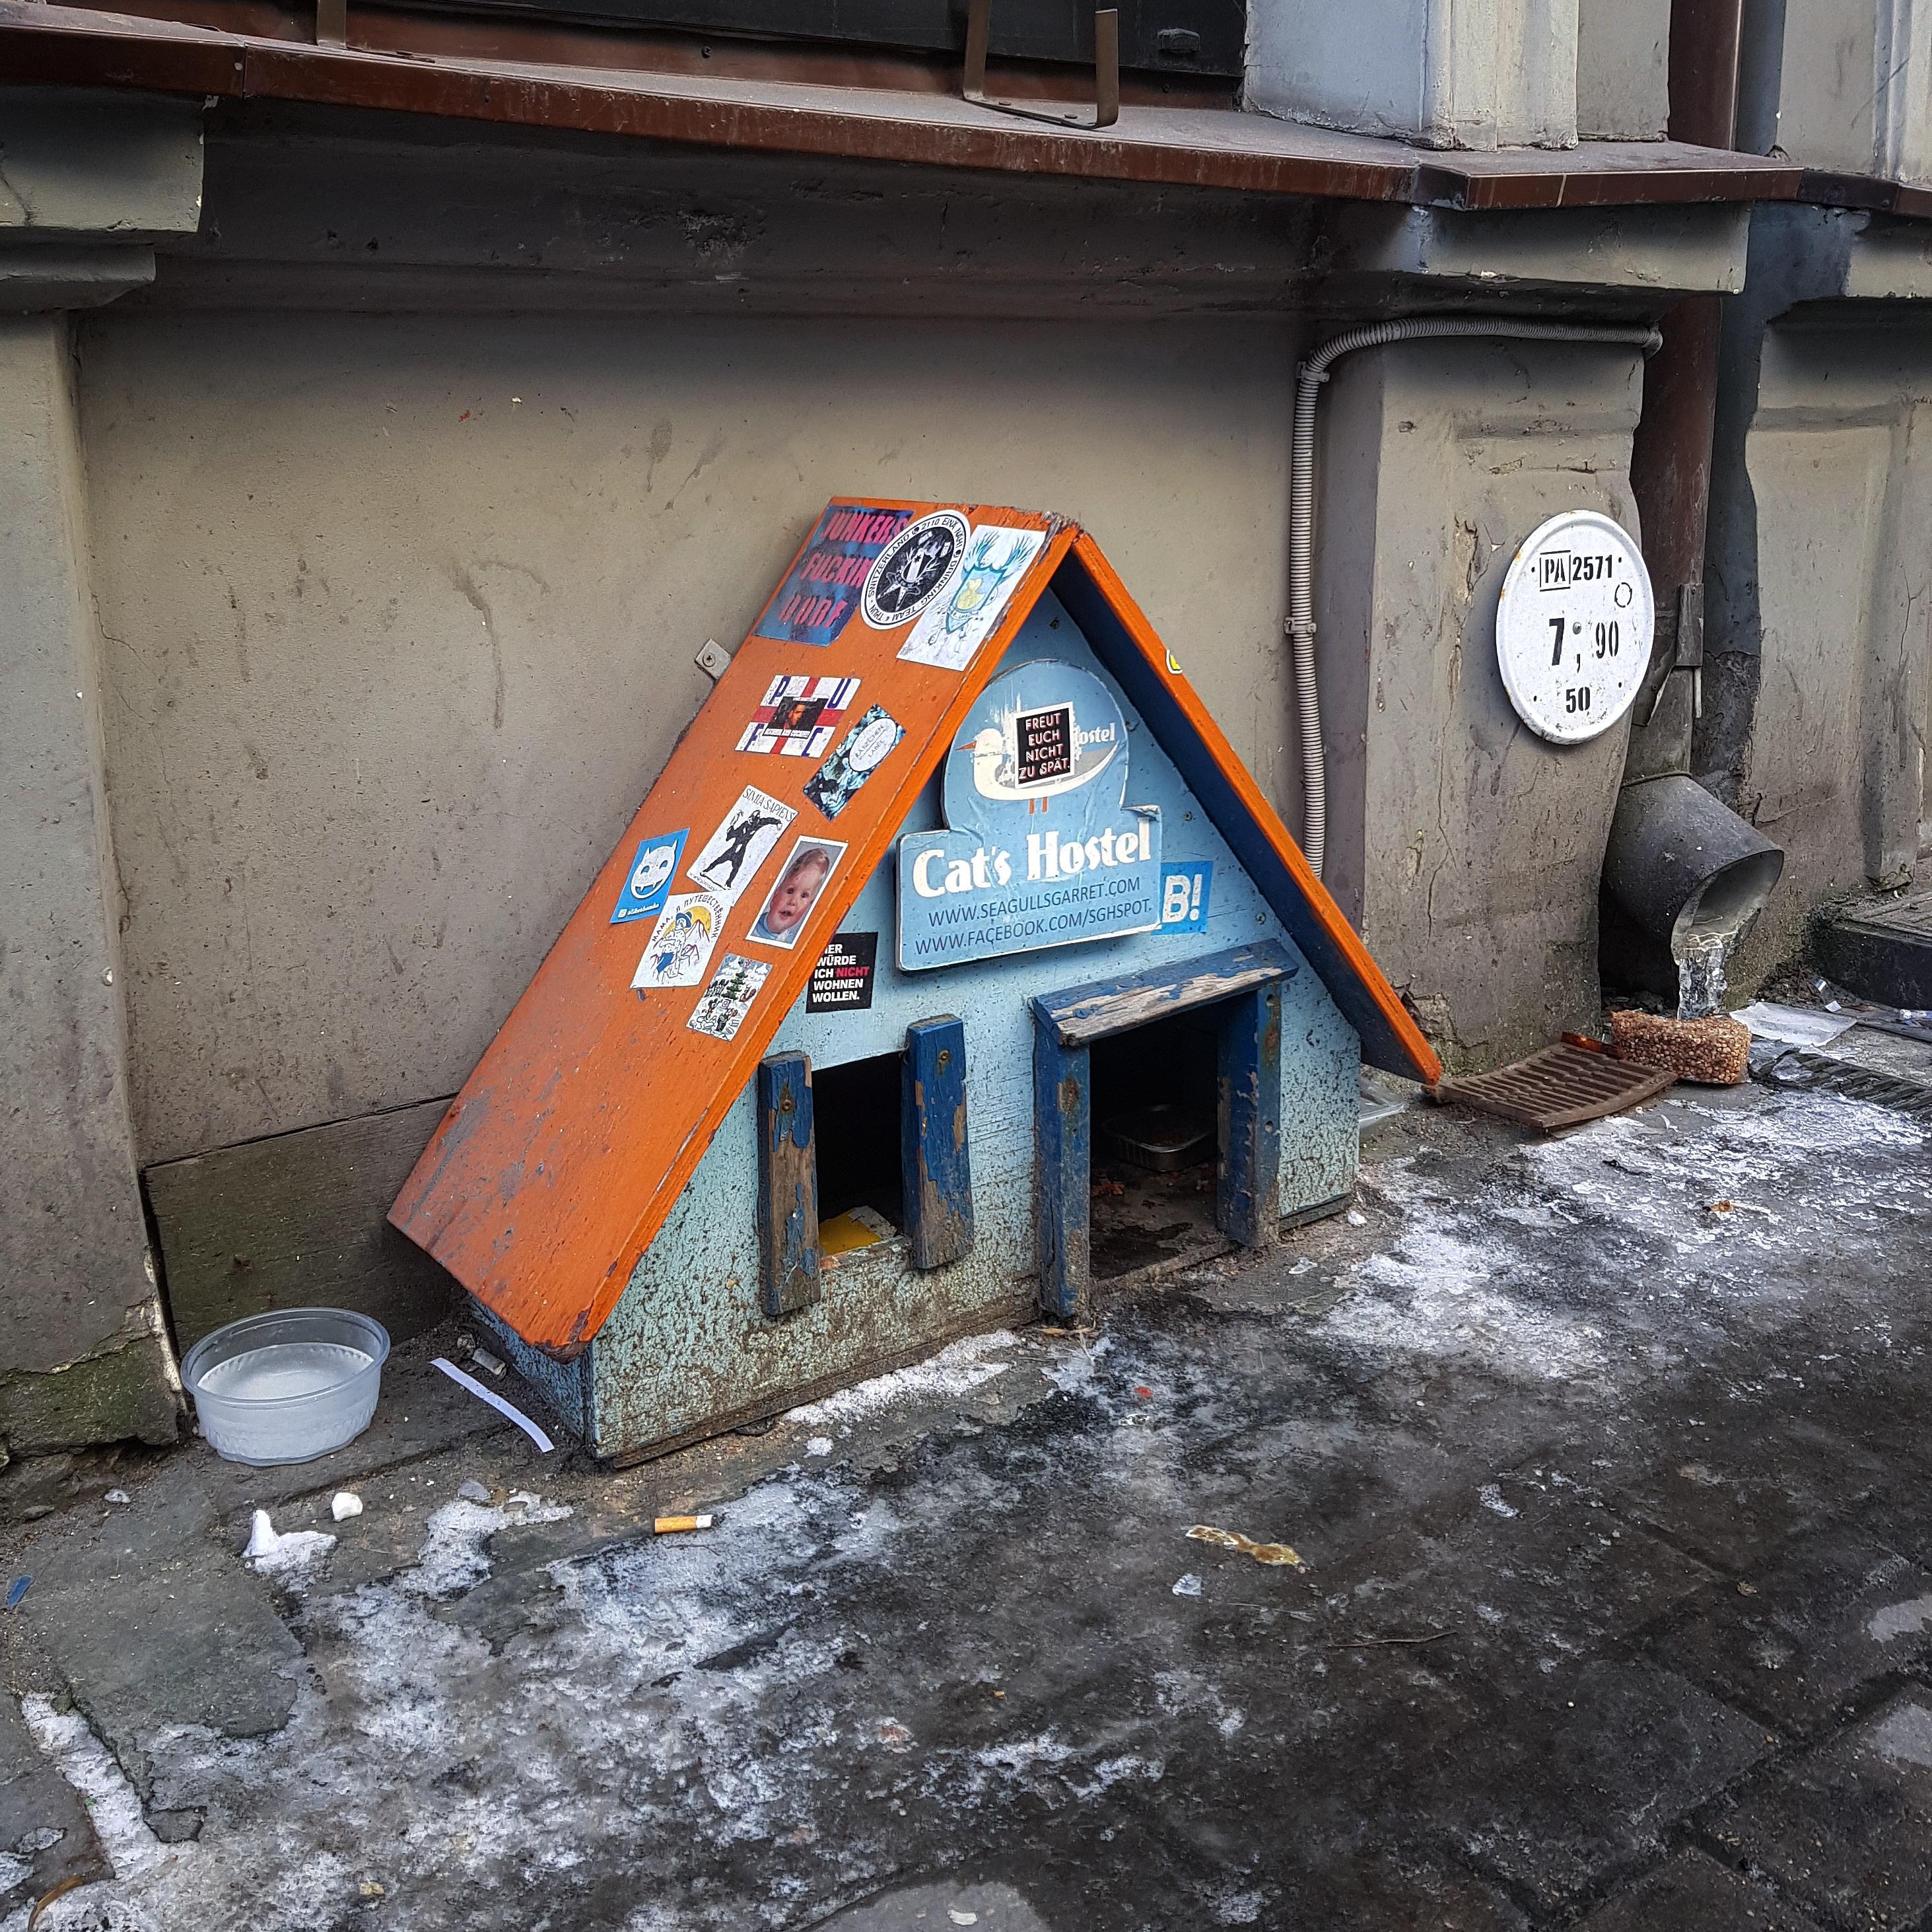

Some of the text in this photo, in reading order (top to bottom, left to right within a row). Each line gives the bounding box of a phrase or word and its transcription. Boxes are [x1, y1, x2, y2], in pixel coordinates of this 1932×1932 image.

[868, 535, 910, 598] SWITZERLAND
[1545, 555, 1612, 583] PA 2571
[892, 560, 957, 621] DRINKING TEAM
[1566, 687, 1590, 713] 50
[1025, 712, 1062, 731] FREUT
[1028, 728, 1061, 746] EUCH
[1074, 722, 1116, 745] ostel
[1025, 743, 1064, 763] NICHT
[1018, 757, 1070, 780] ZU SPÄT.
[913, 817, 1152, 898] Cat's Hostel
[928, 876, 1140, 926] WWW.SEAGULLSGARRET.COM
[1162, 874, 1203, 922] B!
[824, 944, 843, 954] IER
[814, 966, 870, 979] ICH NICHT
[817, 955, 856, 967] WÜRDE
[812, 990, 860, 1002] WOLLEN.
[813, 979, 864, 990] WOHNEN
